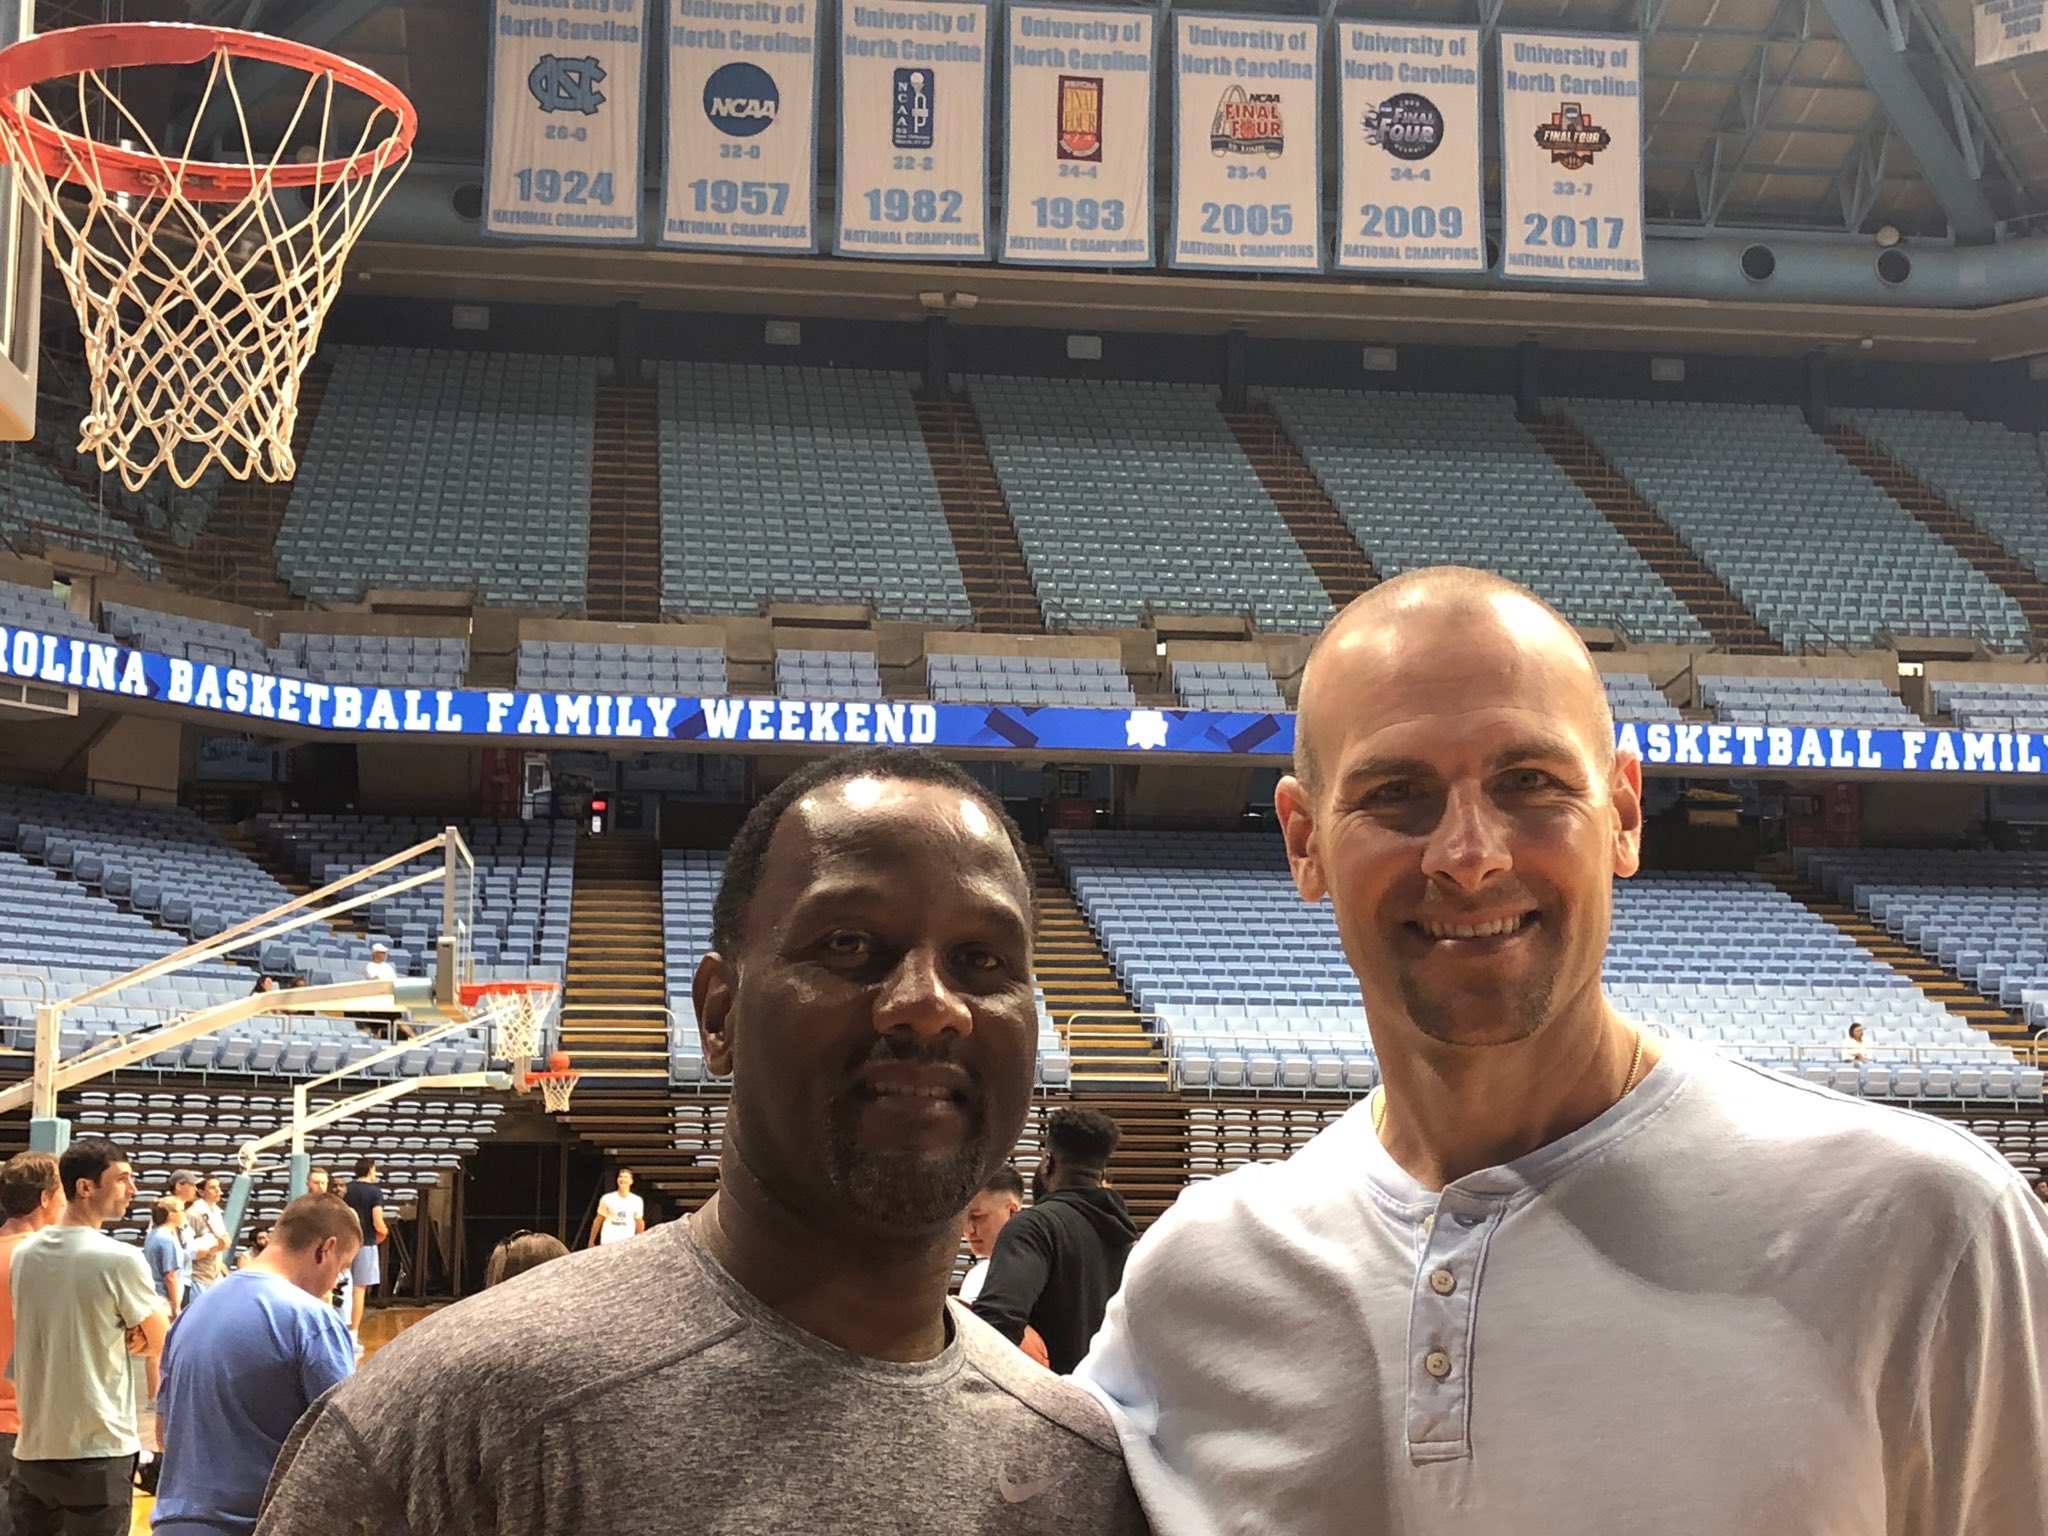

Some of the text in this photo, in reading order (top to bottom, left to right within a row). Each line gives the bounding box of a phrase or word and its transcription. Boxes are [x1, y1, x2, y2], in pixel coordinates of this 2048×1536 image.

[680, 0, 804, 24] University of
[854, 6, 976, 33] University of
[500, 14, 639, 43] North Carolina
[673, 26, 811, 54] North Carolina
[1020, 15, 1141, 42] University of
[1189, 25, 1307, 51] University of
[845, 35, 981, 63] North Carolina
[1352, 31, 1466, 57] University of
[1514, 42, 1628, 68] University of
[1014, 45, 1147, 71] North Carolina
[1181, 54, 1313, 81] North Carolina
[1344, 59, 1475, 85] North Carolina
[1507, 70, 1637, 97] North Carolina
[710, 97, 776, 119] NCAA
[1250, 93, 1280, 103] NCAA
[1225, 103, 1278, 120] FINAL
[1543, 130, 1600, 144] FINAL FOUR
[719, 144, 761, 160] 32-0
[514, 168, 615, 205] 1924
[1390, 168, 1431, 182] 34-4
[688, 179, 790, 216] 1957
[1553, 181, 1593, 196] 33-7
[863, 188, 964, 224] 1982
[1031, 196, 1125, 231] 1993
[1201, 202, 1293, 236] 2005
[492, 209, 634, 230] NATIONAL CHAMPIONS
[667, 218, 807, 239] NATIONAL CHAMPIONS
[1360, 204, 1463, 239] 2009
[1524, 212, 1624, 250] 2017
[844, 228, 981, 247] NATIONAL CHAMPIONS
[1010, 235, 1145, 253] NATIONAL CHAMPIONS
[1180, 240, 1314, 258] NATIONAL CHAMPIONS
[1343, 243, 1479, 261] NATIONAL CHAMPIONS
[1509, 252, 1640, 273] NATIONAL CHAMPIONS
[168, 659, 462, 733] BASKETBALL
[486, 692, 677, 737] FAMILY
[701, 698, 937, 744] WEEKEND
[1617, 723, 2048, 772] ASKETBALL FAMIL
